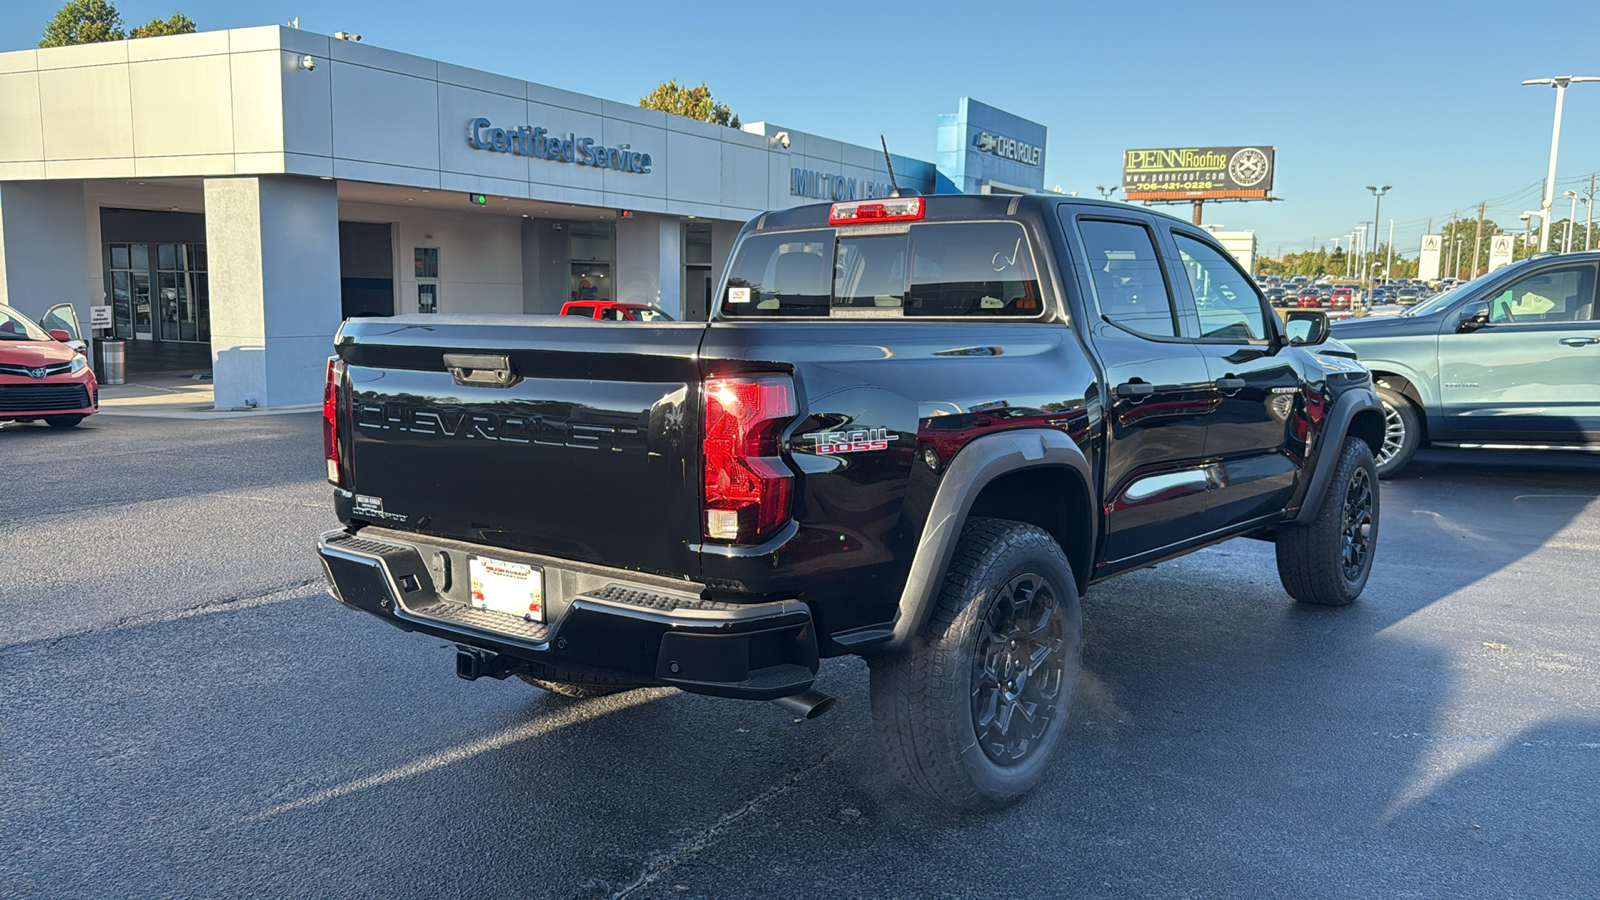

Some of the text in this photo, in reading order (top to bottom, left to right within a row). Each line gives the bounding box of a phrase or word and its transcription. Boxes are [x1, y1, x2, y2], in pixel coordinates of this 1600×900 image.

[467, 117, 652, 174] Certified Service
[996, 135, 1042, 166] CHEVROLET
[1127, 150, 1187, 168] PENN
[1185, 151, 1227, 170] Roofing
[791, 168, 857, 201] MILTON
[1126, 172, 1225, 183] www.pennroof.com
[1136, 182, 1212, 190] 706-421-0226
[358, 406, 638, 452] CHEVROLET
[803, 428, 899, 445] TRAIL
[816, 440, 888, 455] BOSS
